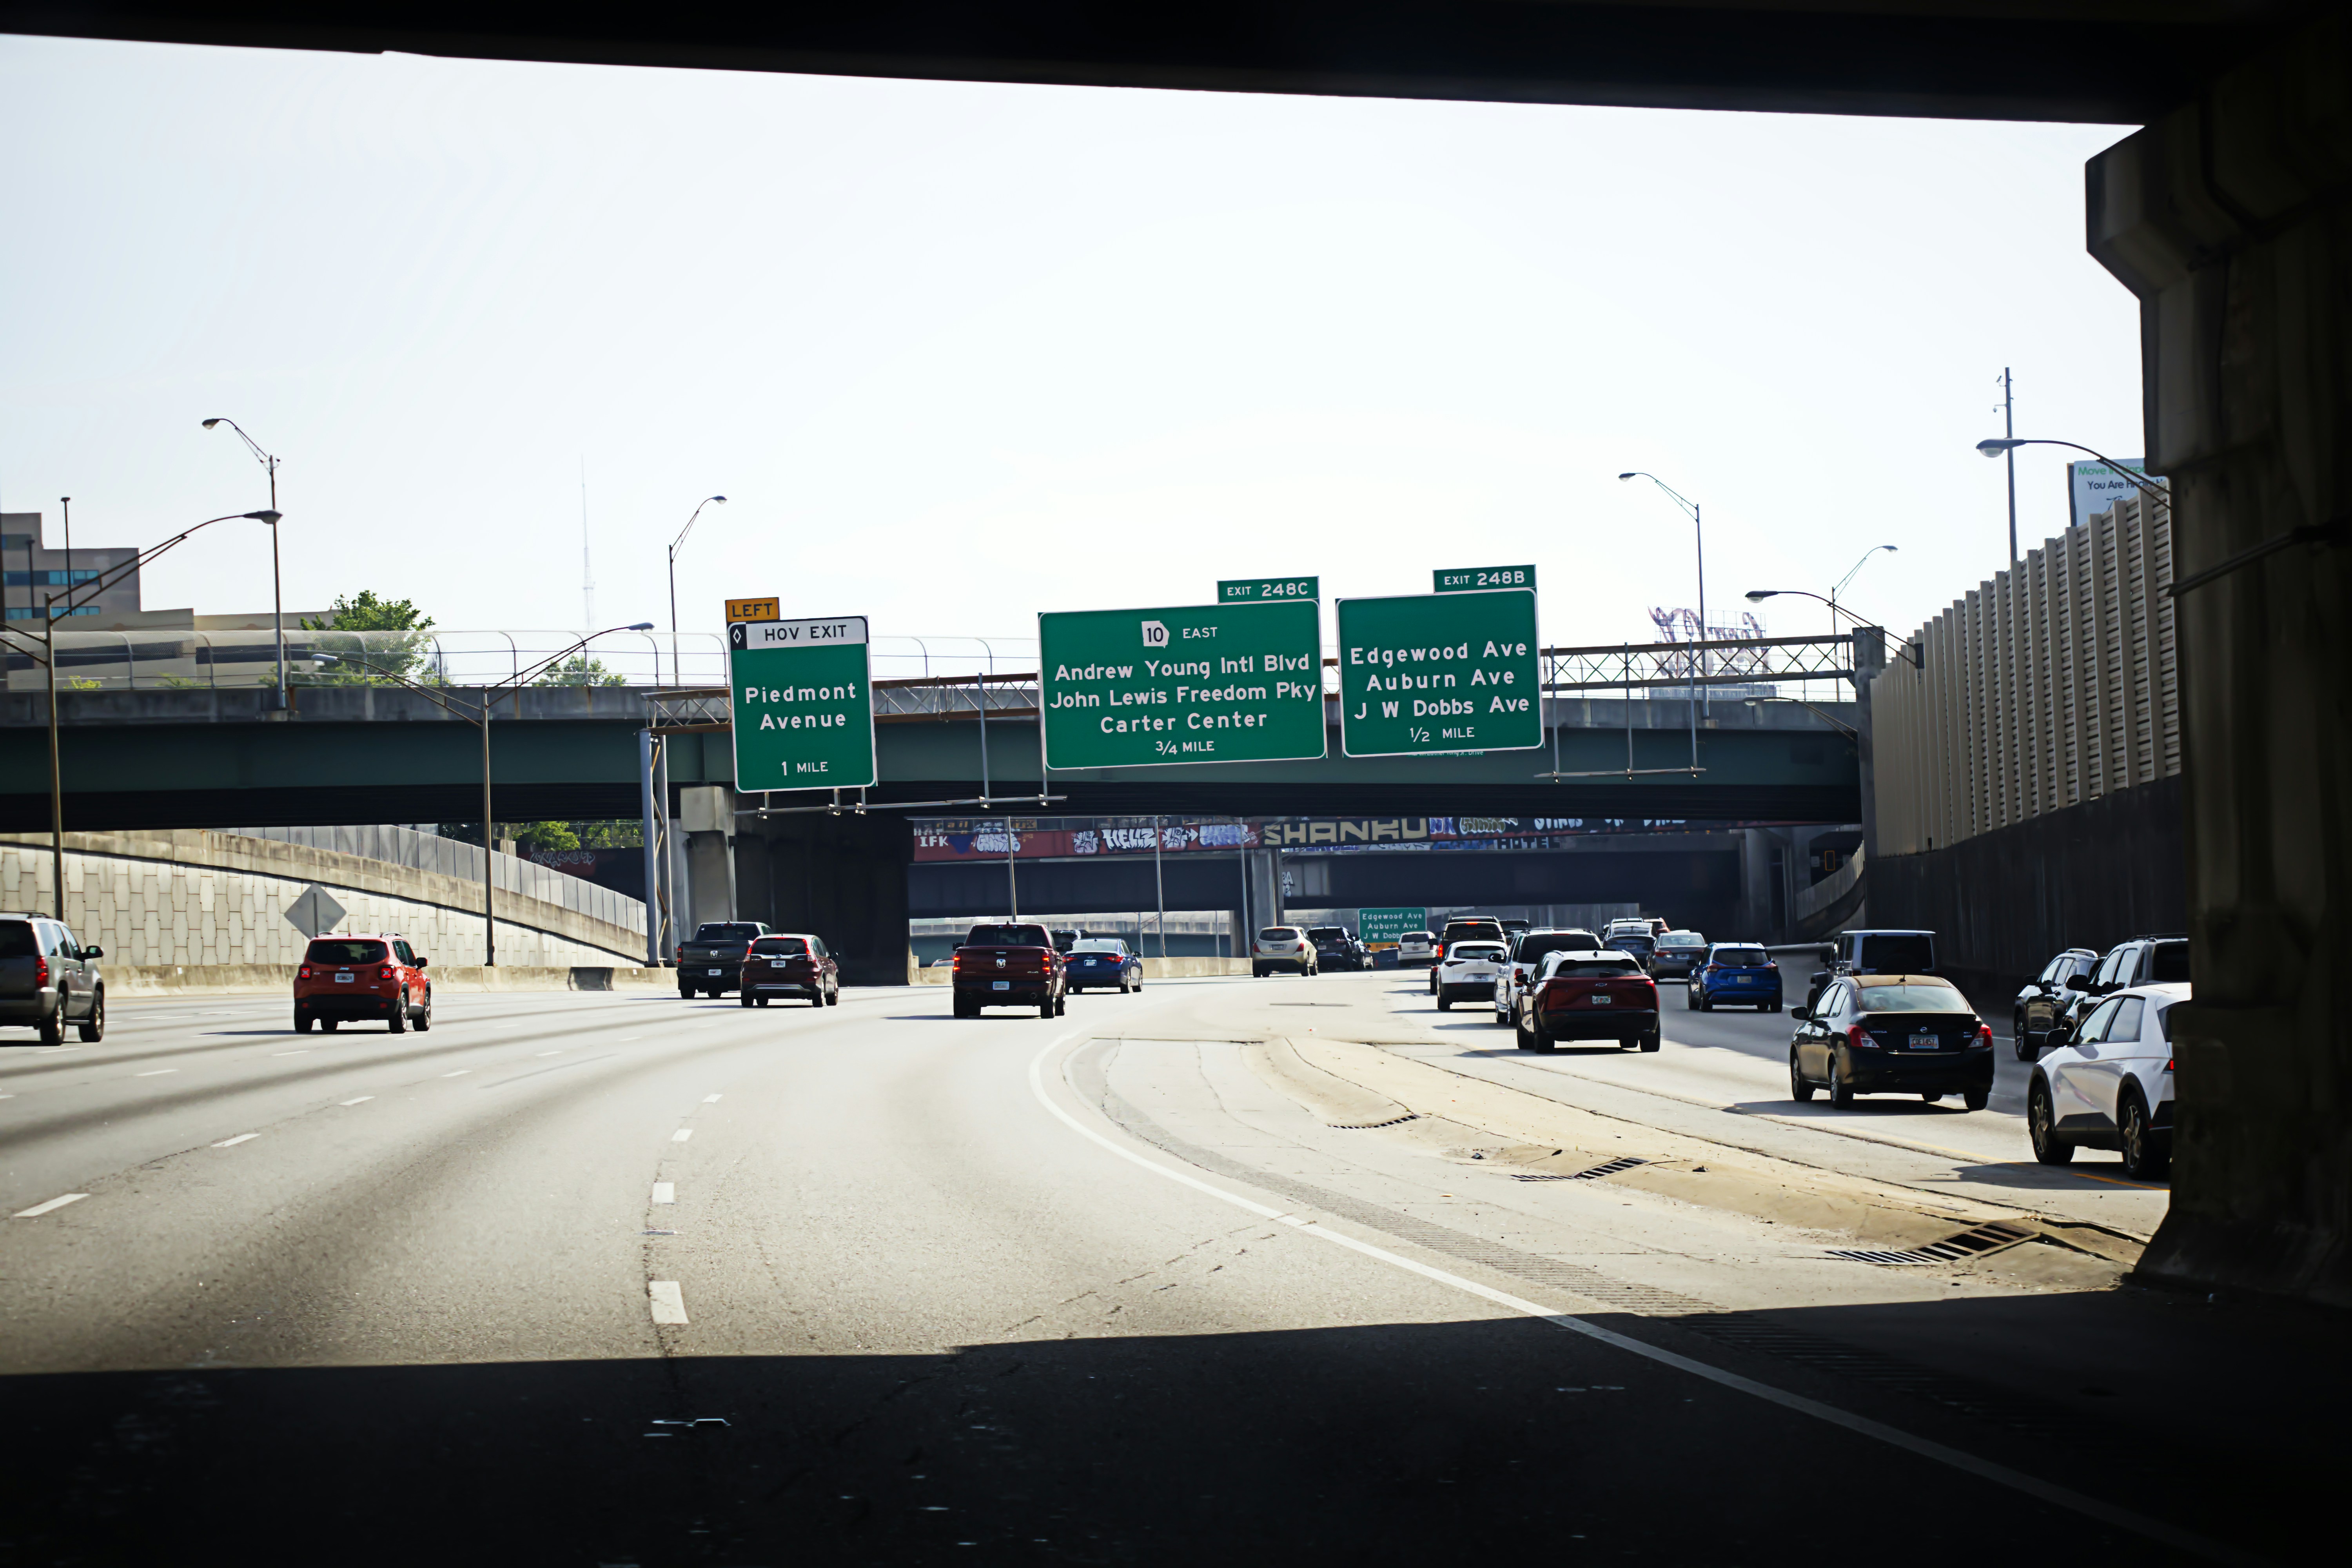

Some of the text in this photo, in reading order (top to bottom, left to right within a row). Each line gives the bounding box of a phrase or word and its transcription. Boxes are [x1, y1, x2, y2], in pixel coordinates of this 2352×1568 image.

[2078, 466, 2106, 475] Move
[2088, 481, 2105, 490] You
[2108, 480, 2124, 489] Are
[1445, 571, 1524, 585] EXIT 248B
[1228, 582, 1308, 597] EXIT 248C
[732, 603, 772, 617] LEFT
[765, 625, 846, 641] HOV EXIT
[1147, 627, 1164, 642] 10
[1183, 627, 1217, 638] EAST
[1351, 641, 1526, 668] Edgewood Ave
[1055, 653, 1308, 681] Andrew Young Intl Blvd
[1367, 669, 1514, 691] Auburn Ave
[746, 683, 855, 703] Piedmont
[1050, 682, 1316, 708] John Lewis Freedom Pky
[1354, 696, 1529, 719] J W Dobbs Ave
[760, 714, 845, 730] Avenue
[1101, 711, 1267, 733] Carter Center
[1410, 727, 1474, 742] 1/2 MILE
[1156, 741, 1214, 755] 3/4 MILE
[782, 762, 828, 775] 1 MILE
